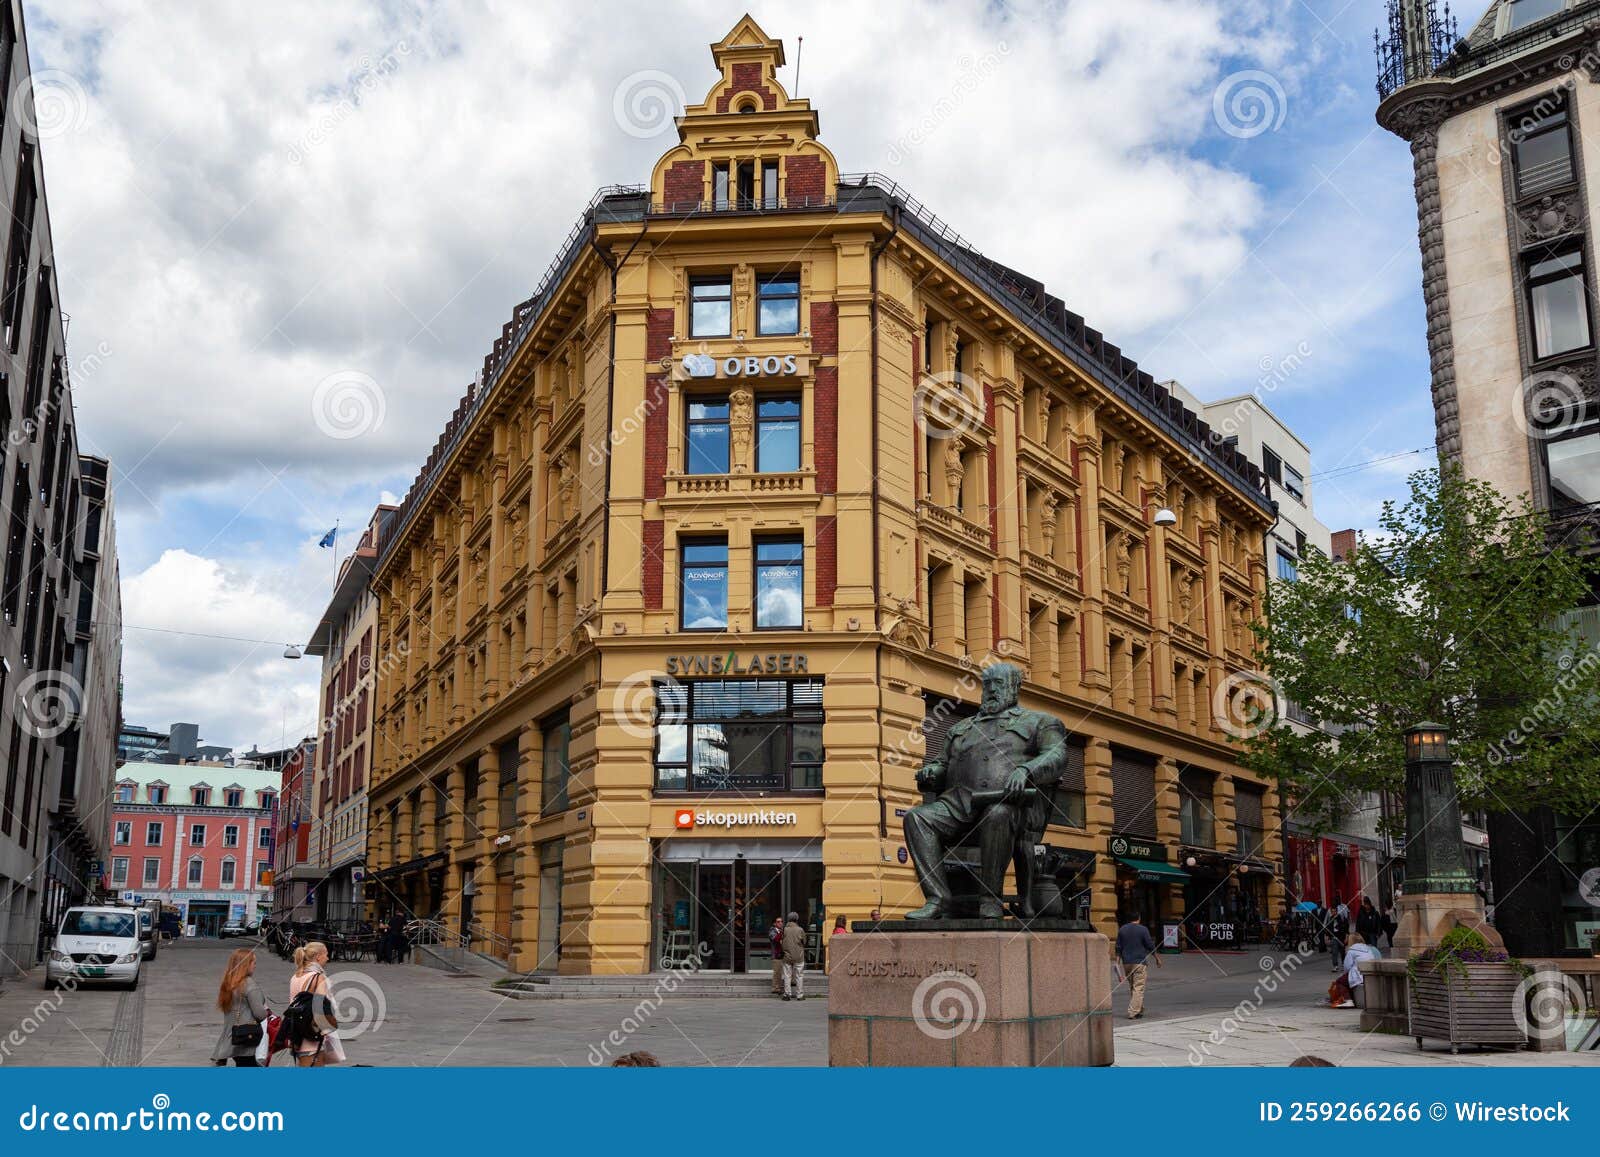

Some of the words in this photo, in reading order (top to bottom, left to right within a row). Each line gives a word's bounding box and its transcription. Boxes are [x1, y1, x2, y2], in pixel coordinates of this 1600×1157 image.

[723, 355, 798, 377] OBOS
[695, 808, 797, 829] skopunkten
[1209, 923, 1234, 931] OPEN
[1210, 931, 1234, 940] PUB
[847, 960, 921, 978] CHRISTIAN
